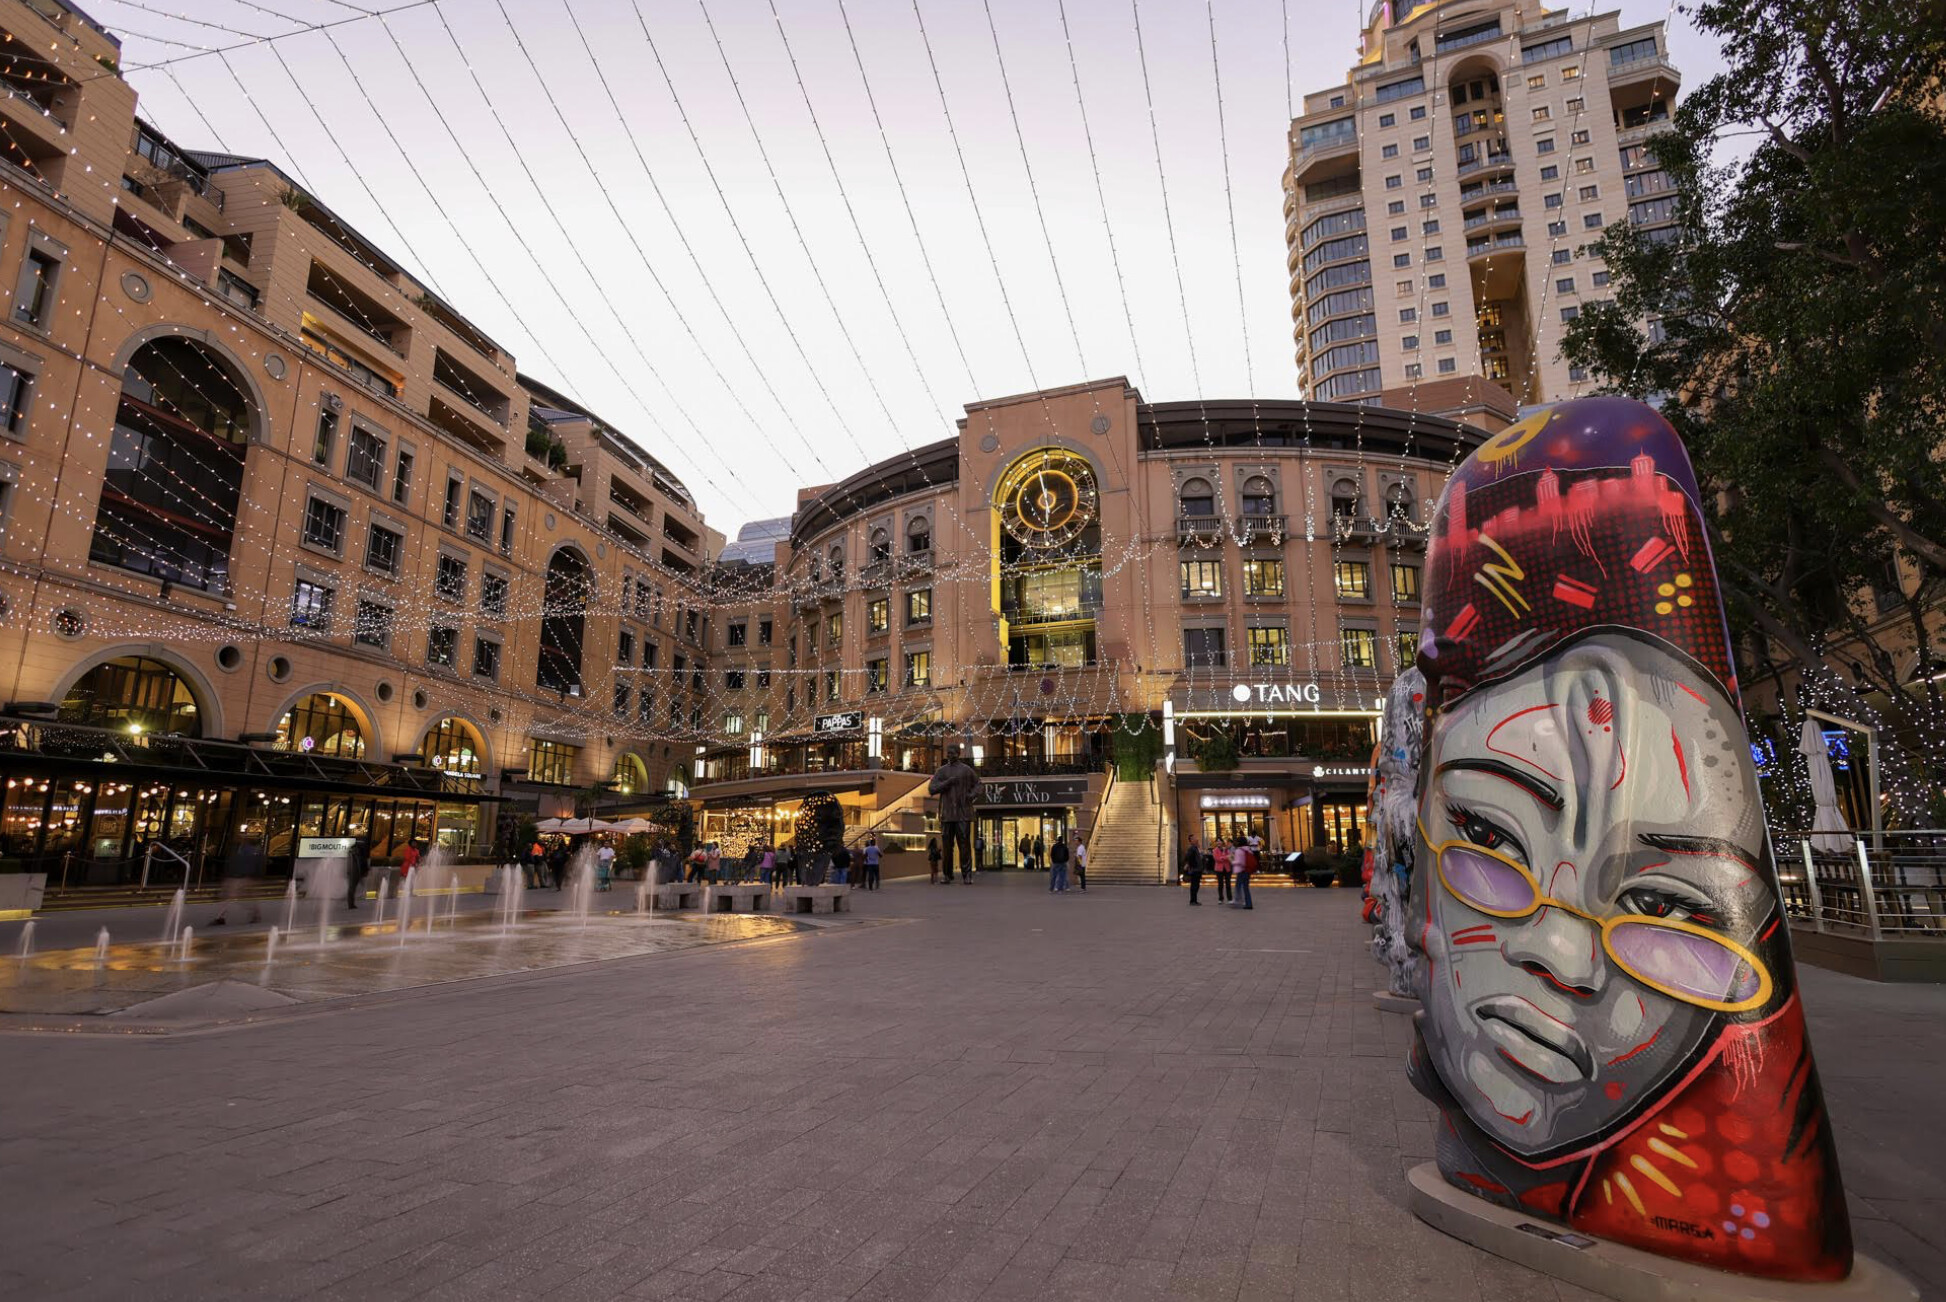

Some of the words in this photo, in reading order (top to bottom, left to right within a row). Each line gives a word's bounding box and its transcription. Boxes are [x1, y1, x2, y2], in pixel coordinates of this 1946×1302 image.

[1254, 684, 1320, 702] TANG
[822, 716, 852, 729] PAPPAS
[1013, 792, 1050, 803] WIND
